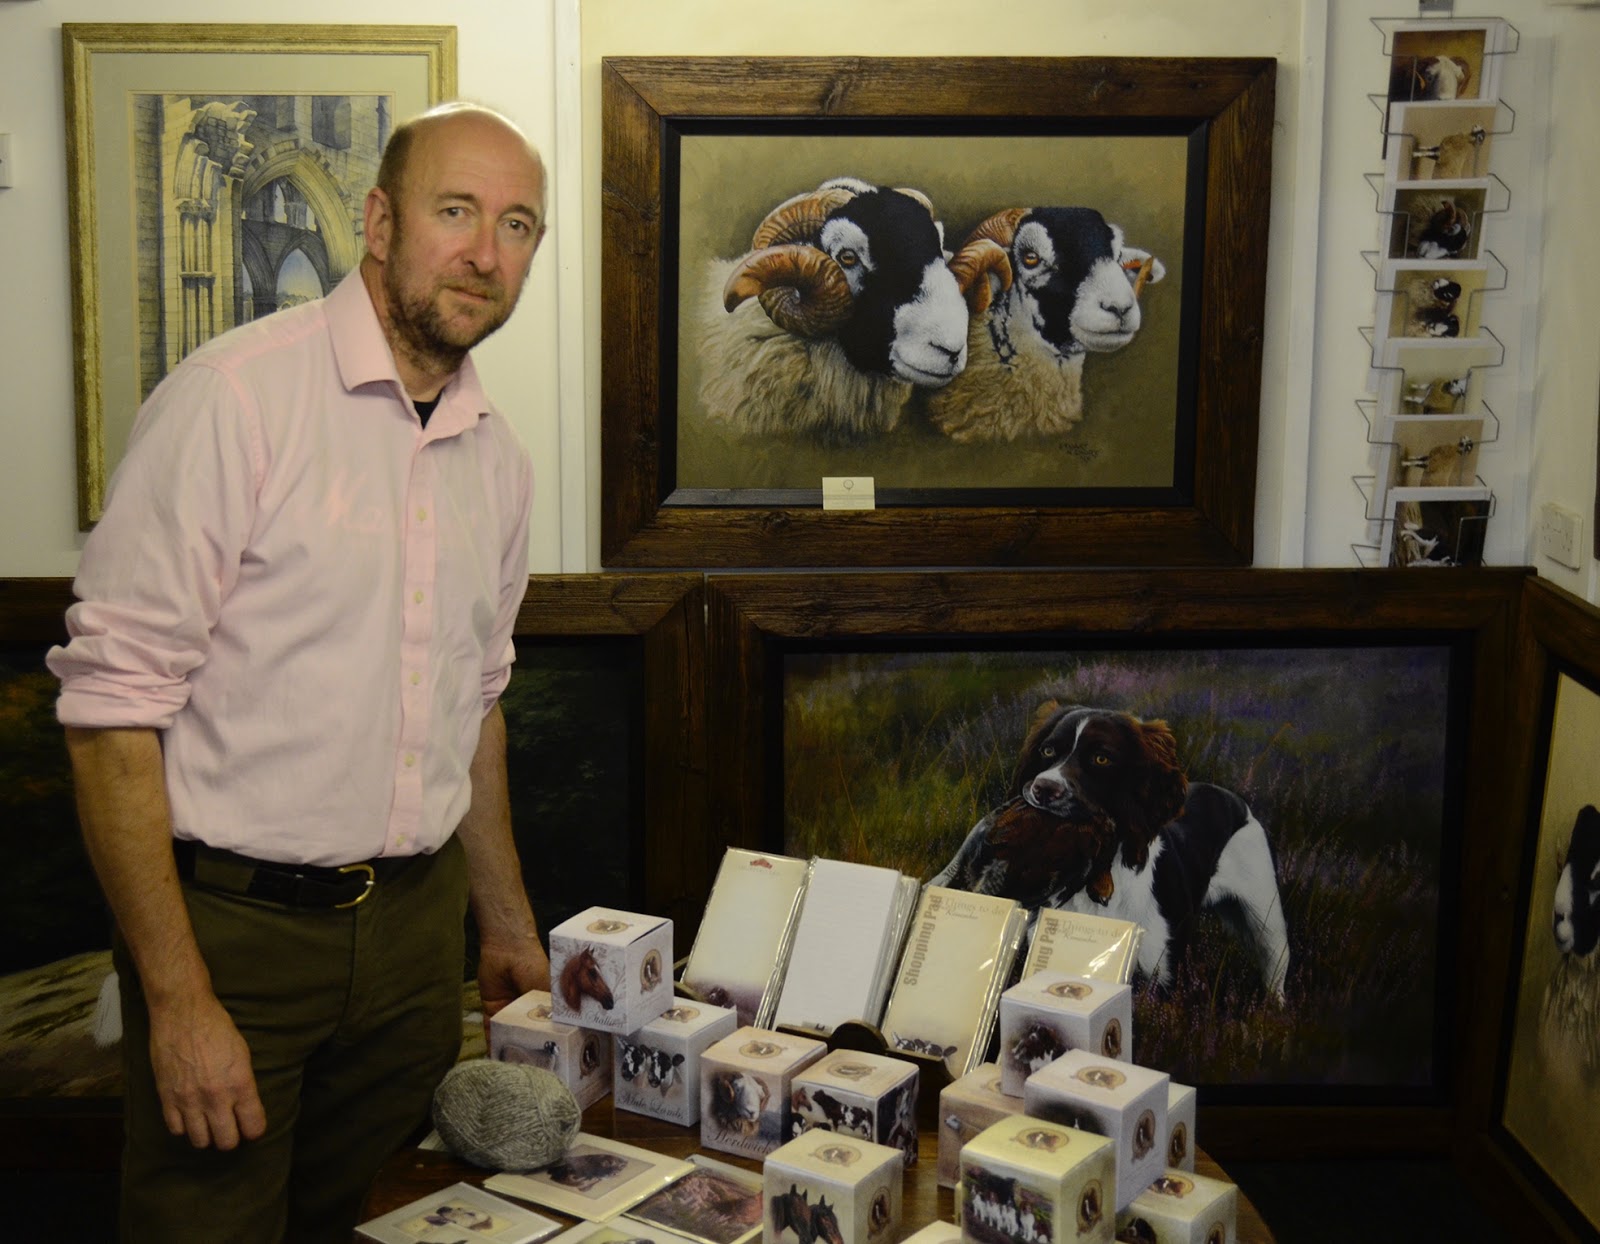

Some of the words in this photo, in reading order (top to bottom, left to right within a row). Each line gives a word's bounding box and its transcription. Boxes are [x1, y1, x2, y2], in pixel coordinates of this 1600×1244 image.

[903, 922, 936, 986] Shopping
[923, 894, 942, 920] Pad
[1040, 917, 1059, 944] Pad
[706, 1129, 773, 1156] Herdwick
